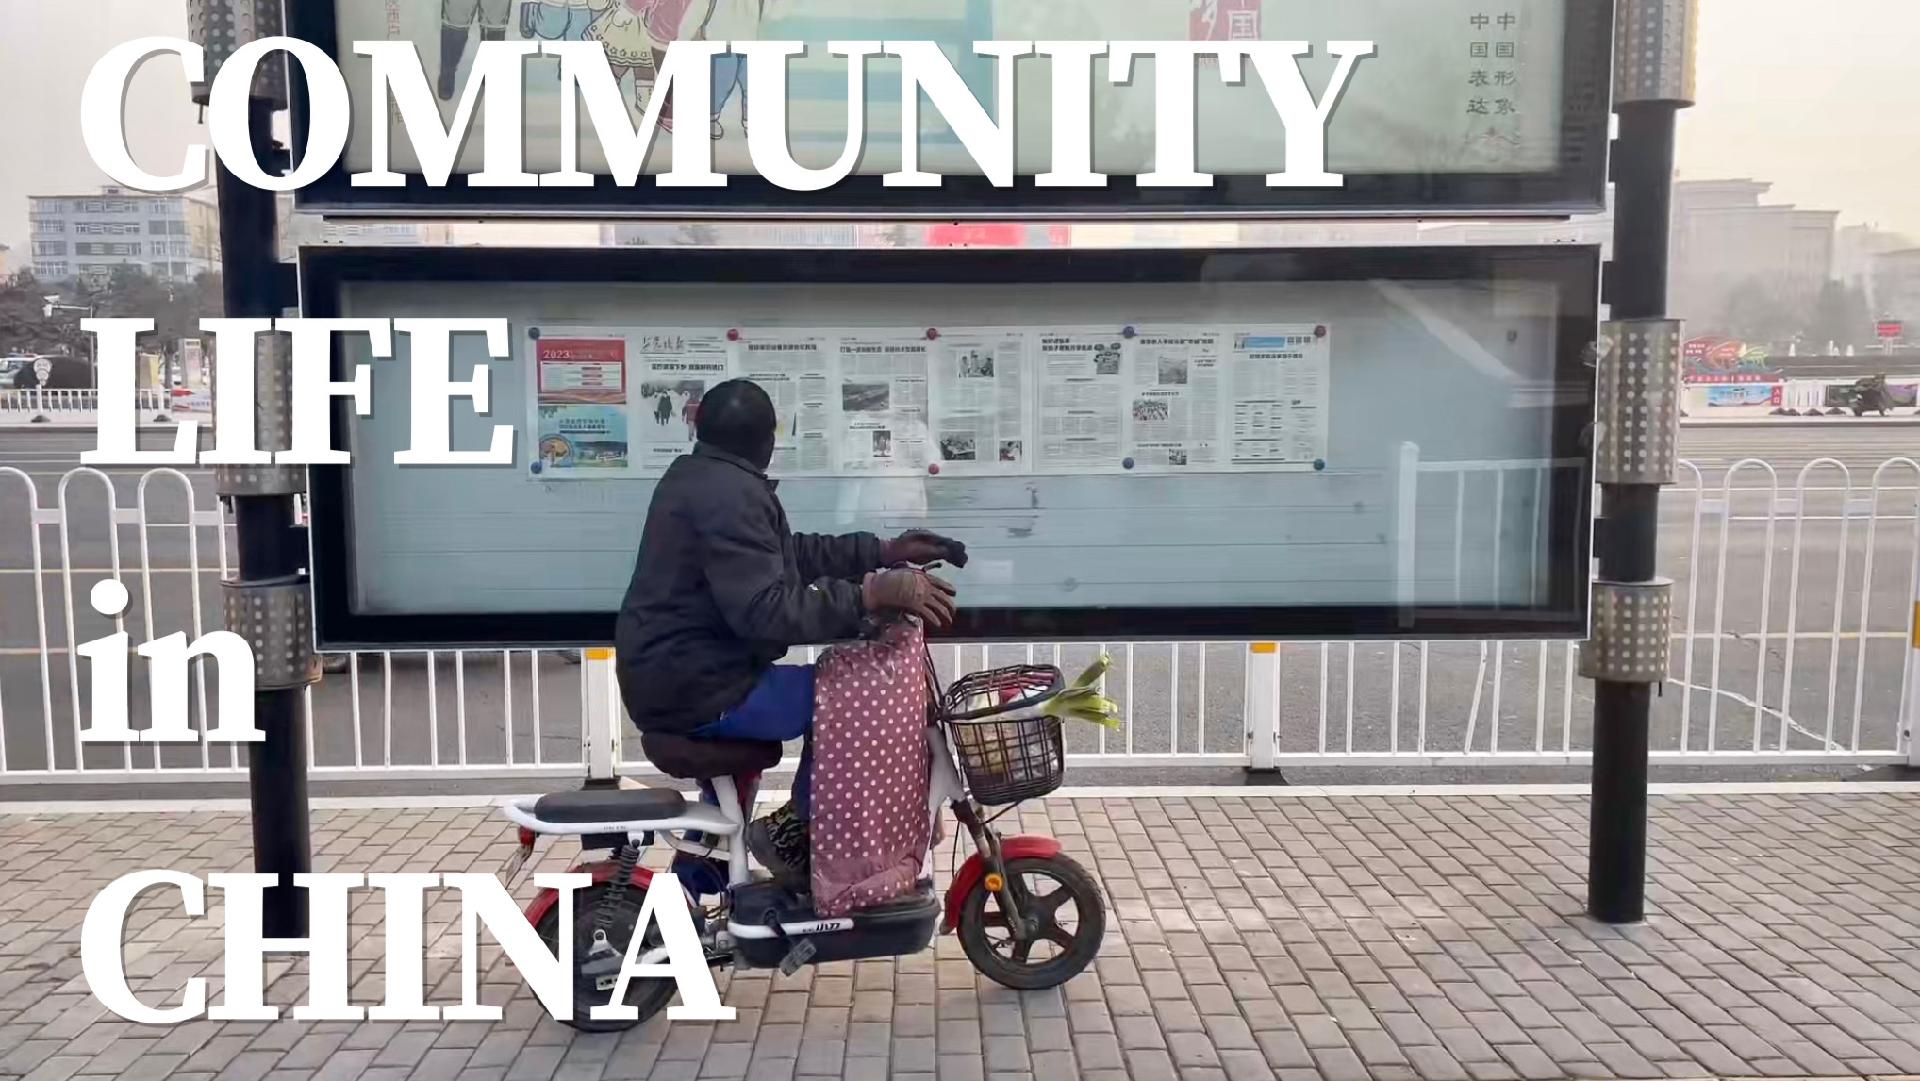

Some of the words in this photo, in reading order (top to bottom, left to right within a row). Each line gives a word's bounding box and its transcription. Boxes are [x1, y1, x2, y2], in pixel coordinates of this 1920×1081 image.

[1466, 12, 1489, 115] 中国表达
[1494, 12, 1516, 115] 中国形象
[543, 350, 570, 359] 2023
